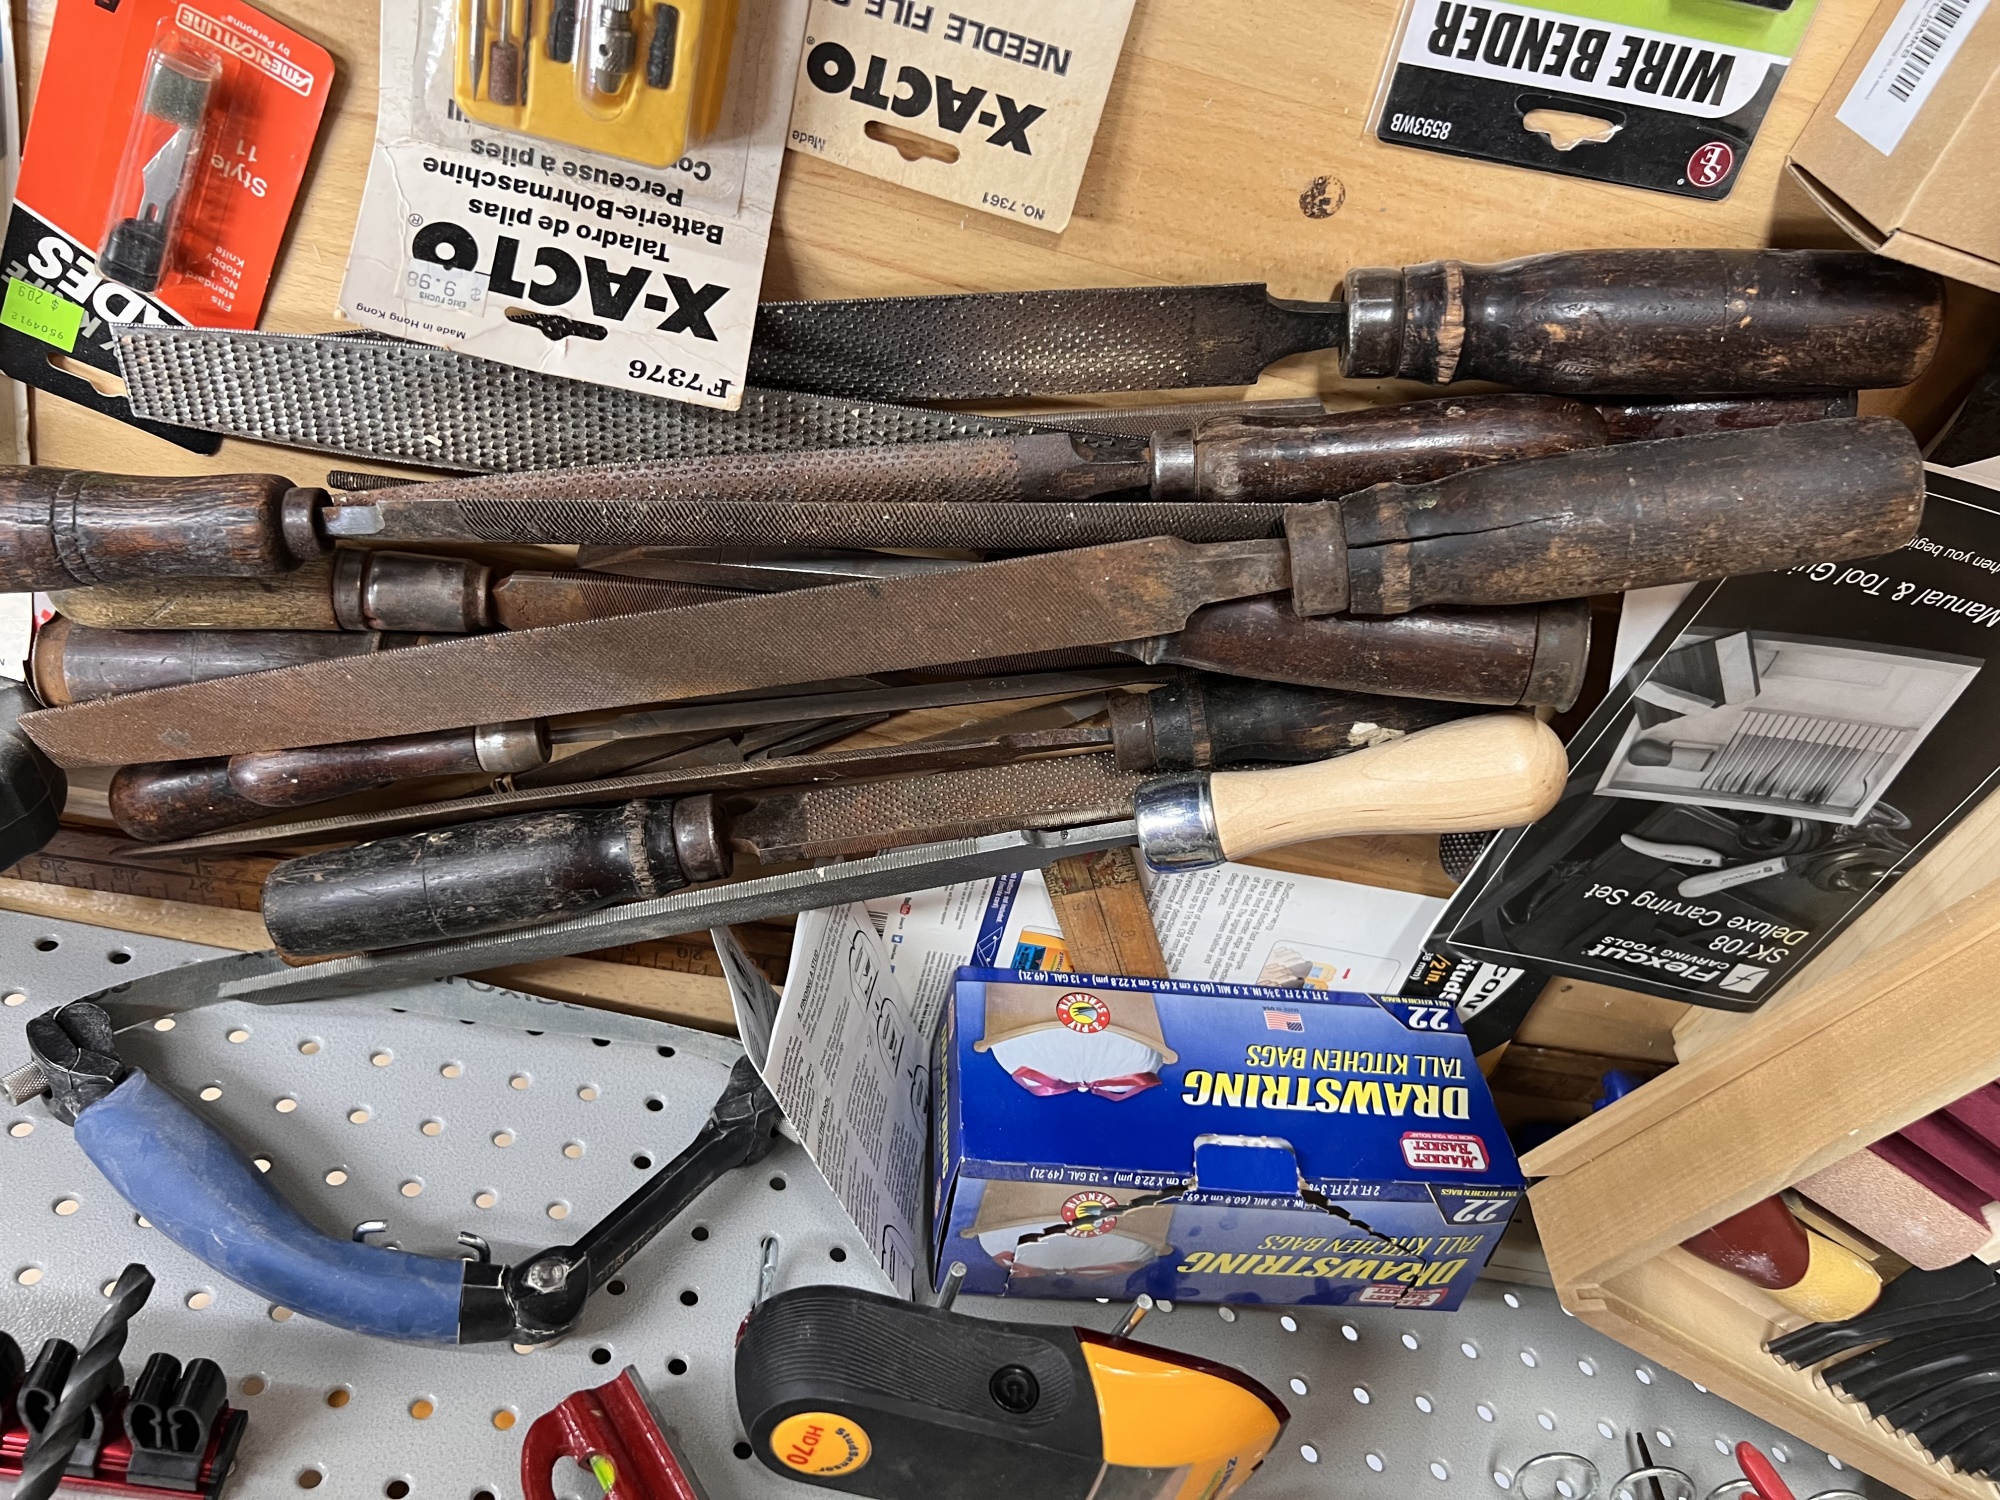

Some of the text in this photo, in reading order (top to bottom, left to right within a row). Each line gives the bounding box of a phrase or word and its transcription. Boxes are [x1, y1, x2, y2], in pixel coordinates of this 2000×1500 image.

[227, 14, 291, 58] by Personna
[865, 0, 1073, 77] NEEDLE FILE
[1427, 1, 1737, 107] WIRE BENDER
[806, 42, 1048, 157] X-ACTO
[1390, 112, 1453, 141] 8593WB
[235, 140, 258, 163] 11
[470, 138, 536, 168] piles
[211, 155, 268, 198] Style
[540, 154, 557, 178] à
[562, 160, 684, 207] Perceuse
[422, 157, 725, 246] Batterie-Bohrmaschine
[981, 191, 1047, 221] NO. 7361
[468, 198, 670, 264] Taladro de pilas
[205, 252, 243, 280] Hobby
[215, 245, 246, 267] Knife
[184, 270, 236, 302] standard
[220, 273, 240, 291] No.
[405, 270, 458, 298] 9.98
[411, 221, 731, 343] X-ACTO
[211, 295, 233, 313] Fits
[418, 291, 468, 309] ERIC FUCHS
[11, 310, 65, 341] 9504912
[355, 302, 467, 340] Made in Hong Kong
[627, 359, 736, 400] F7376
[1944, 547, 1976, 564] you
[1832, 567, 2000, 628] Manual & Tool
[1583, 883, 1810, 946] Deluxe Carving Set
[1601, 936, 1731, 970] CARVING TOOLS
[1708, 935, 1790, 964] SK108
[1216, 960, 1234, 984] directio
[1586, 943, 1722, 983] Flexcut
[1018, 969, 1048, 982] (49.2L)
[1050, 973, 1069, 983] GAL.
[1069, 974, 1080, 984] 13
[1110, 977, 1130, 988] 22.8
[1130, 978, 1138, 988] X
[1137, 979, 1150, 988] cm
[1151, 979, 1171, 990] 69.5
[1171, 981, 1179, 990] X
[1179, 981, 1191, 990] cm
[1193, 981, 1215, 993] (60.9
[1216, 984, 1231, 994] MIL
[1232, 985, 1241, 995] .9
[1241, 986, 1249, 996] X
[1249, 986, 1262, 997] IN.
[1281, 988, 1294, 998] FT.
[1294, 989, 1301, 999] 2
[1301, 990, 1309, 1000] X
[1309, 990, 1321, 1000] FT.
[1321, 991, 1329, 1001] 2
[1057, 992, 1108, 1014] STRENGTH
[1066, 1020, 1102, 1033] 3-PLY
[1406, 1005, 1449, 1031] 22
[1245, 1044, 1466, 1080] TALL KITCHEN BAGS
[1182, 1070, 1471, 1120] DRAWSTRING
[1412, 1140, 1473, 1155] BASKET
[1413, 1153, 1479, 1169] MARKET
[1029, 1167, 1065, 1181] (49.2L)
[1067, 1170, 1087, 1181] GAL.
[1087, 1172, 1100, 1183] 13
[1134, 1175, 1156, 1186] 22.8
[1225, 1193, 1270, 1207] MIL (60.9
[1451, 1198, 1502, 1223] 22
[1256, 1234, 1485, 1257] TALL KITCHEN BAGS
[1176, 1250, 1470, 1287] DRAWSTRING
[786, 1425, 825, 1466] HD70
[819, 1427, 859, 1473] StudSensor
